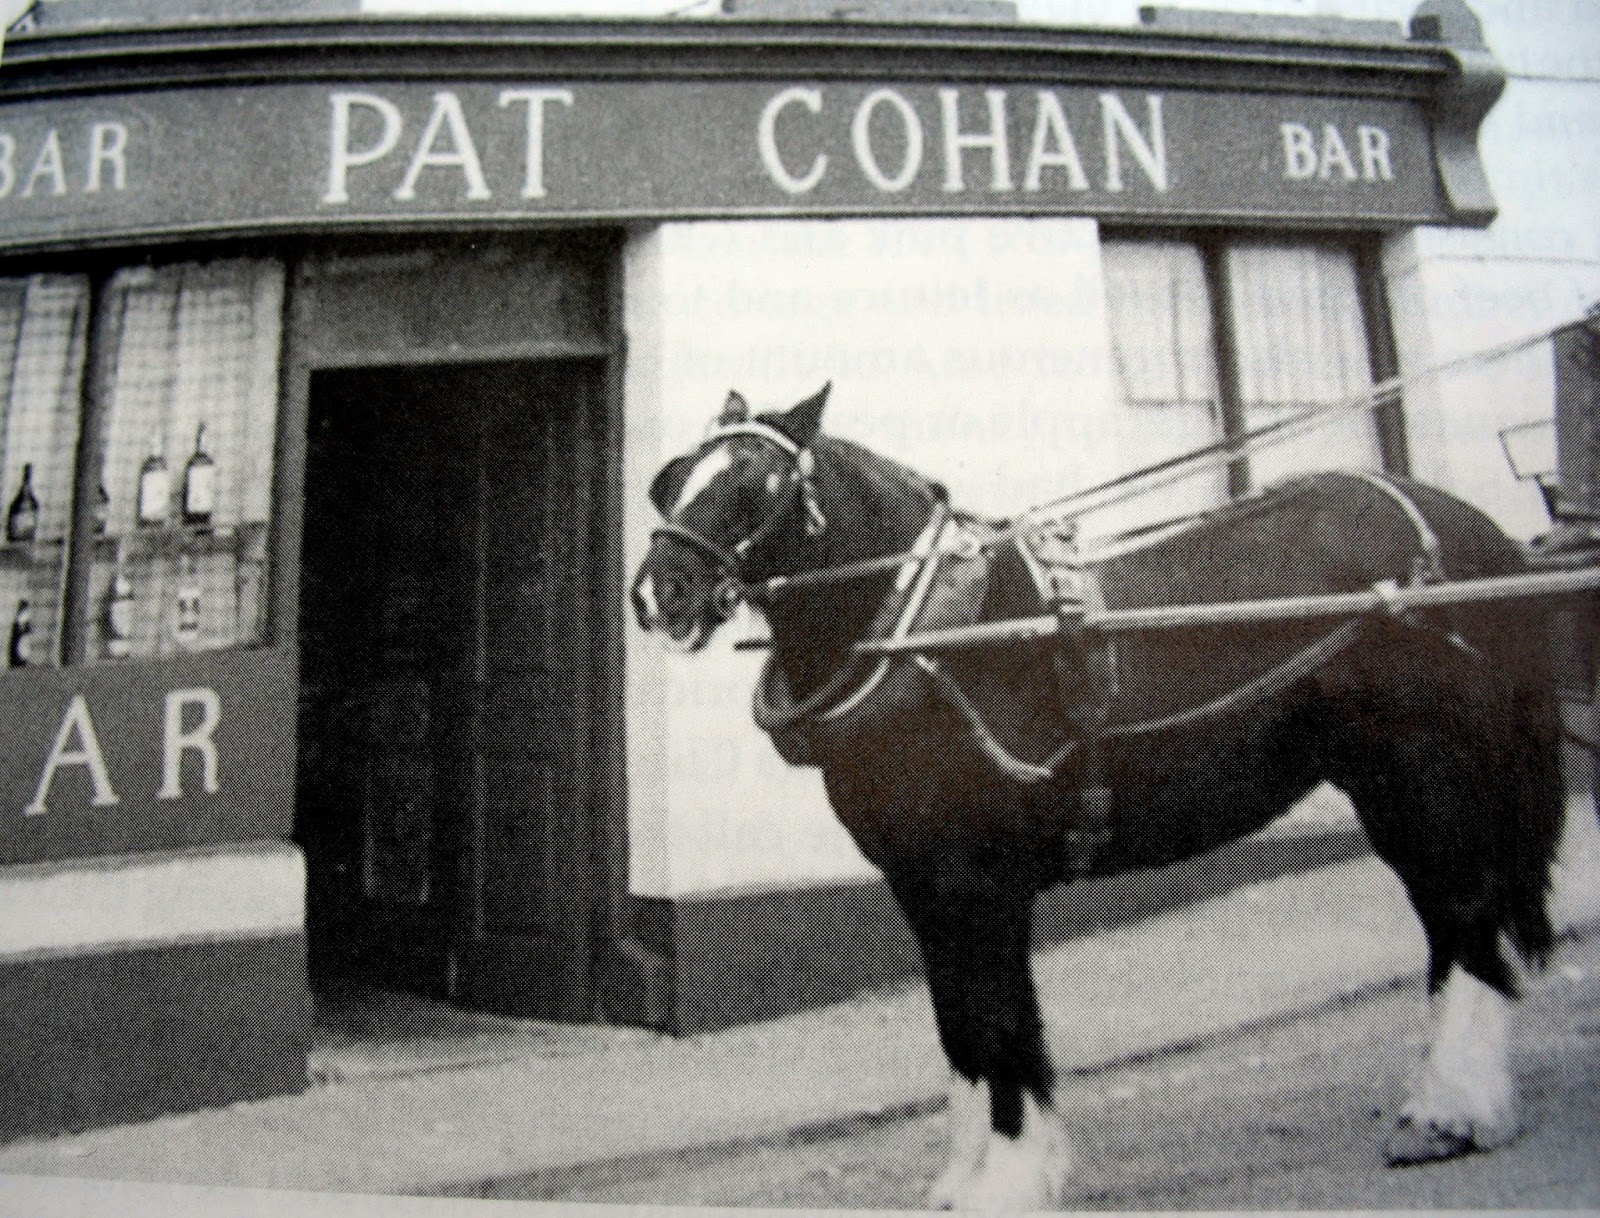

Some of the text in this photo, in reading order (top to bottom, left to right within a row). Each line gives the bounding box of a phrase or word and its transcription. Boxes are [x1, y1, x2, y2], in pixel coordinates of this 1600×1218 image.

[323, 90, 575, 202] PAT
[757, 86, 1169, 194] COHAN
[1280, 121, 1395, 180] BAR
